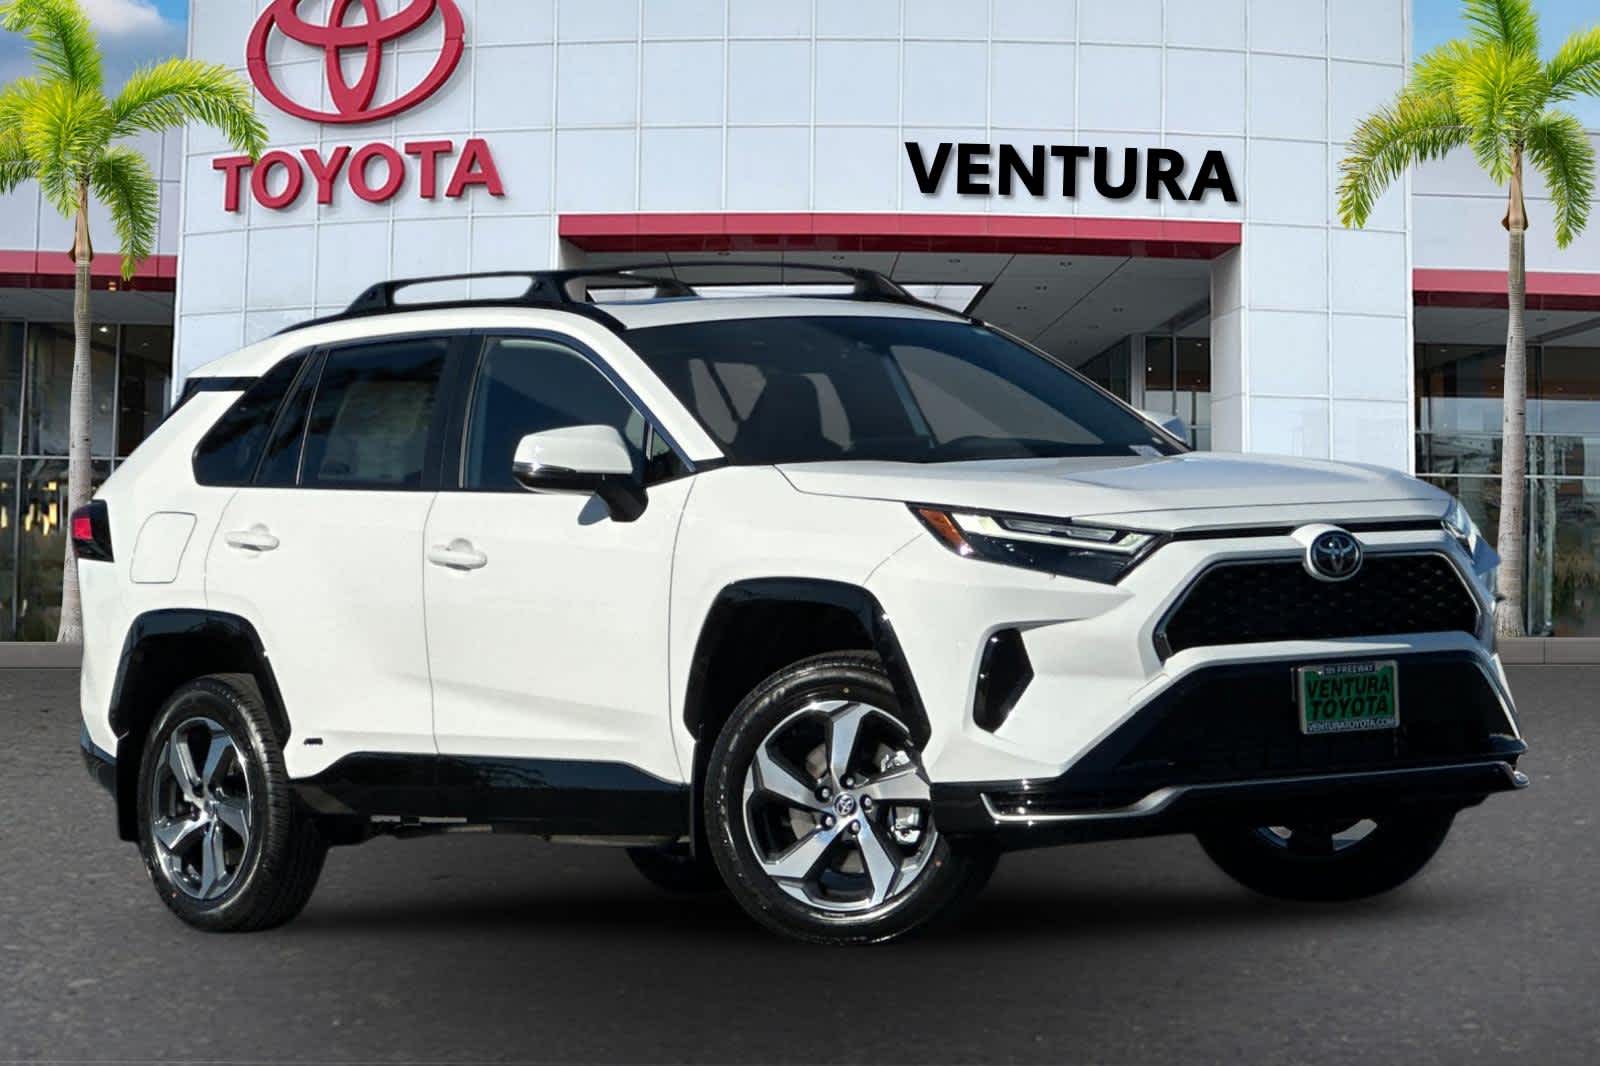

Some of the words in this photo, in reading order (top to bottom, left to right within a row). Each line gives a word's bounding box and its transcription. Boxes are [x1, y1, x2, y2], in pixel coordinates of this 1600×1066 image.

[213, 138, 505, 212] TOYOTA
[904, 141, 1239, 202] VENTURA
[1307, 675, 1390, 699] VENTURA
[1312, 696, 1388, 719] TOYOTA
